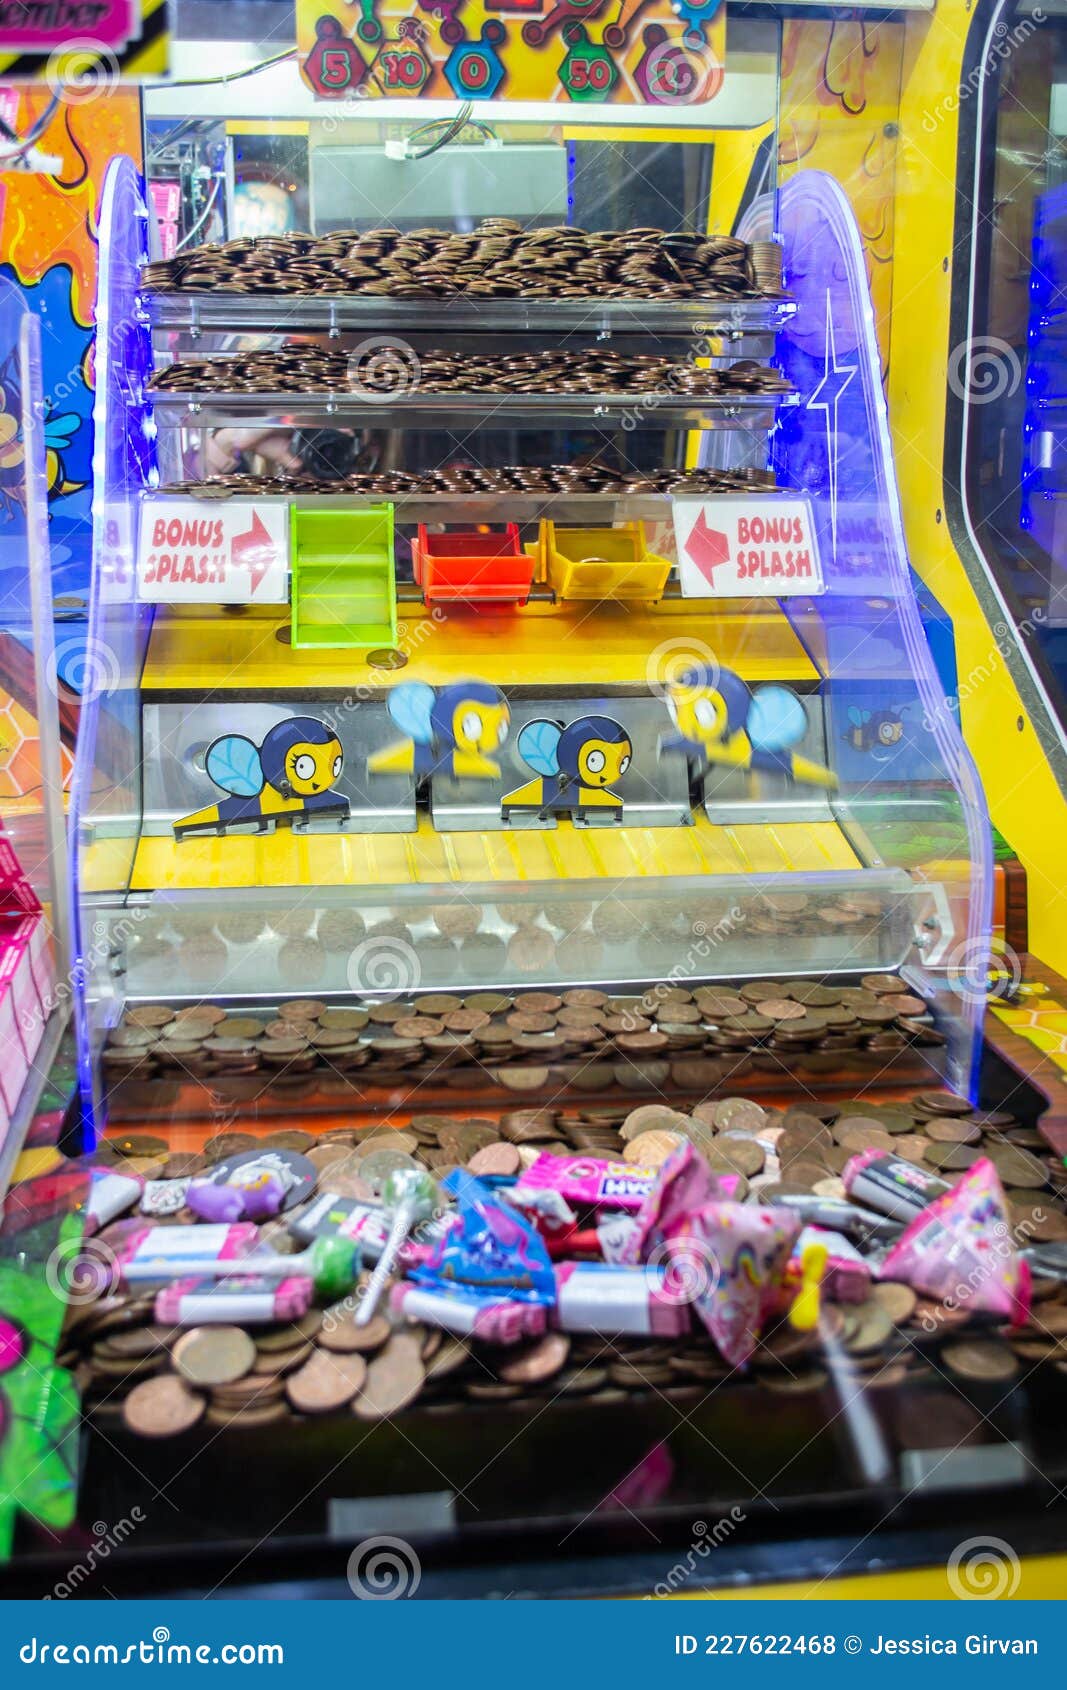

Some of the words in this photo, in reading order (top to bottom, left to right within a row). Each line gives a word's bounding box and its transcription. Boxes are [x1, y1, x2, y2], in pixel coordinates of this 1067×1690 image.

[322, 49, 350, 88] 5
[381, 52, 426, 88] 10
[459, 52, 490, 90] 0
[568, 58, 610, 91] 50
[152, 518, 223, 548] BONUS
[738, 517, 804, 544] BONUS
[144, 554, 226, 583] SPLASH
[737, 549, 812, 579] SPLASH
